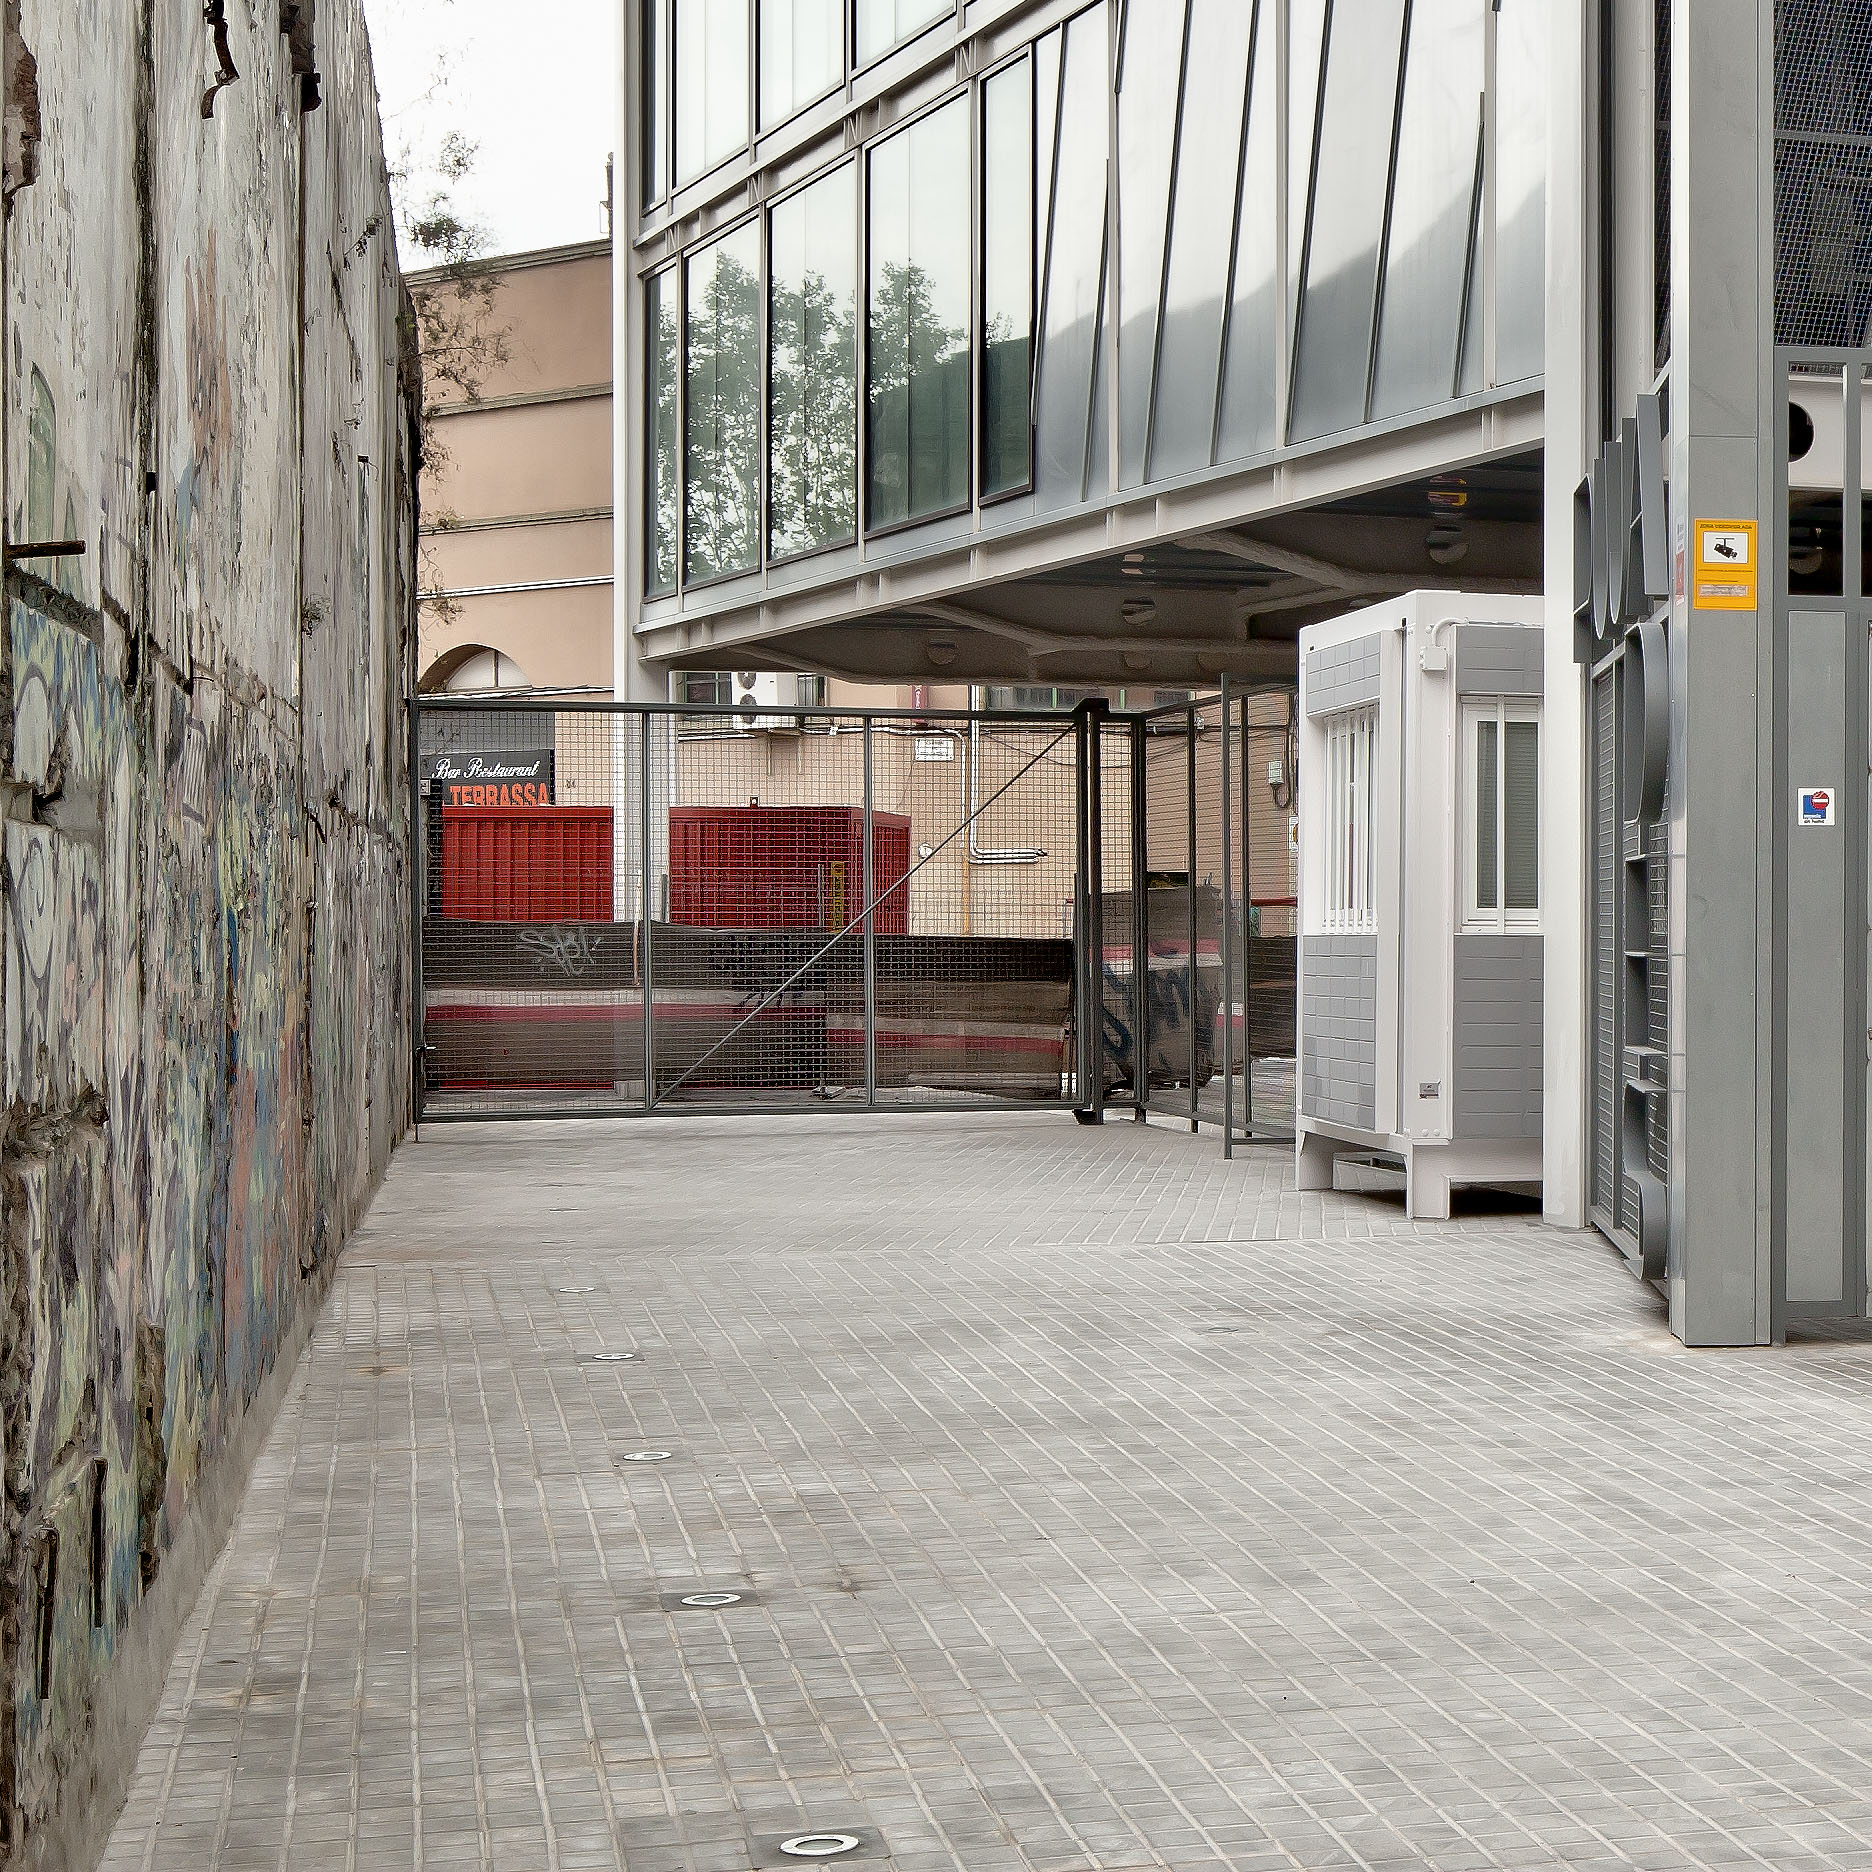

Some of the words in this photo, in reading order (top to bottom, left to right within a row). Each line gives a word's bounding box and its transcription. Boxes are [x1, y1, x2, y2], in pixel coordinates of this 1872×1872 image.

[431, 758, 461, 780] Bar
[463, 757, 541, 779] Restaurant
[449, 782, 550, 806] TERRASSA
